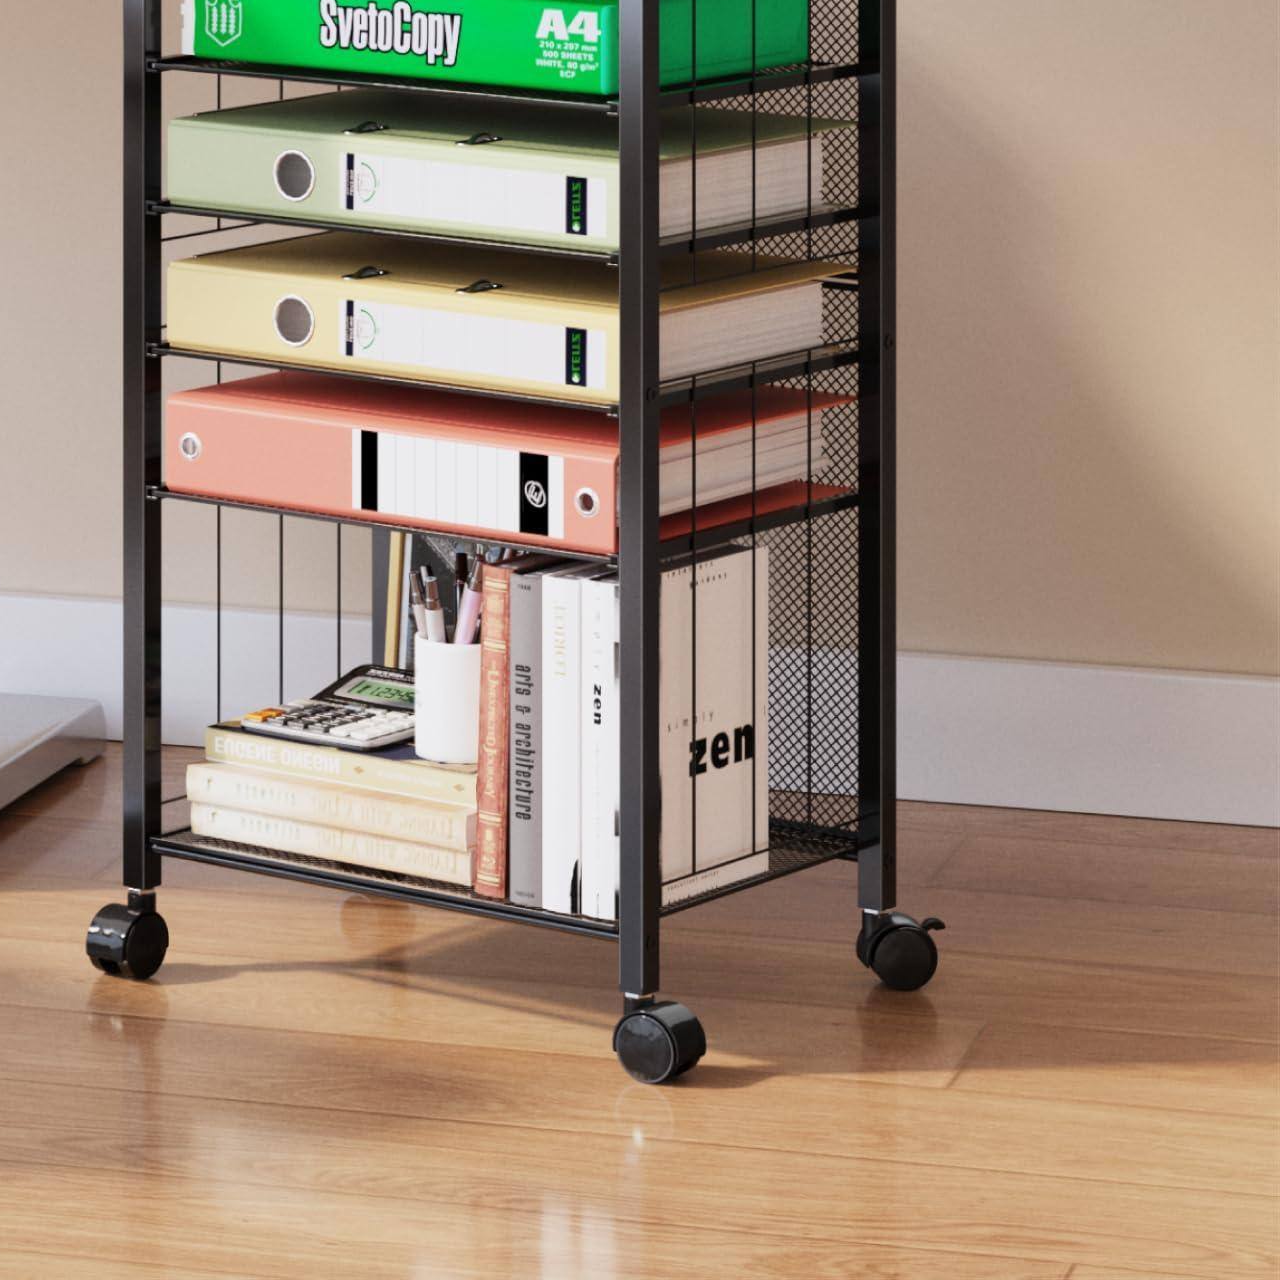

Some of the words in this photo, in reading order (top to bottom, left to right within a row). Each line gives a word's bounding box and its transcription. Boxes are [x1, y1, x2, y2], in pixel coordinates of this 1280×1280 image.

[535, 8, 602, 43] A4
[539, 40, 555, 49] 210
[563, 42, 579, 51] 297
[581, 44, 598, 52] mm
[543, 50, 559, 59] 500
[561, 51, 594, 62] SHEETS
[515, 664, 534, 696] arts
[515, 704, 532, 715] &
[593, 684, 602, 725] zen
[689, 723, 754, 777] zen
[515, 722, 535, 820] architecture
